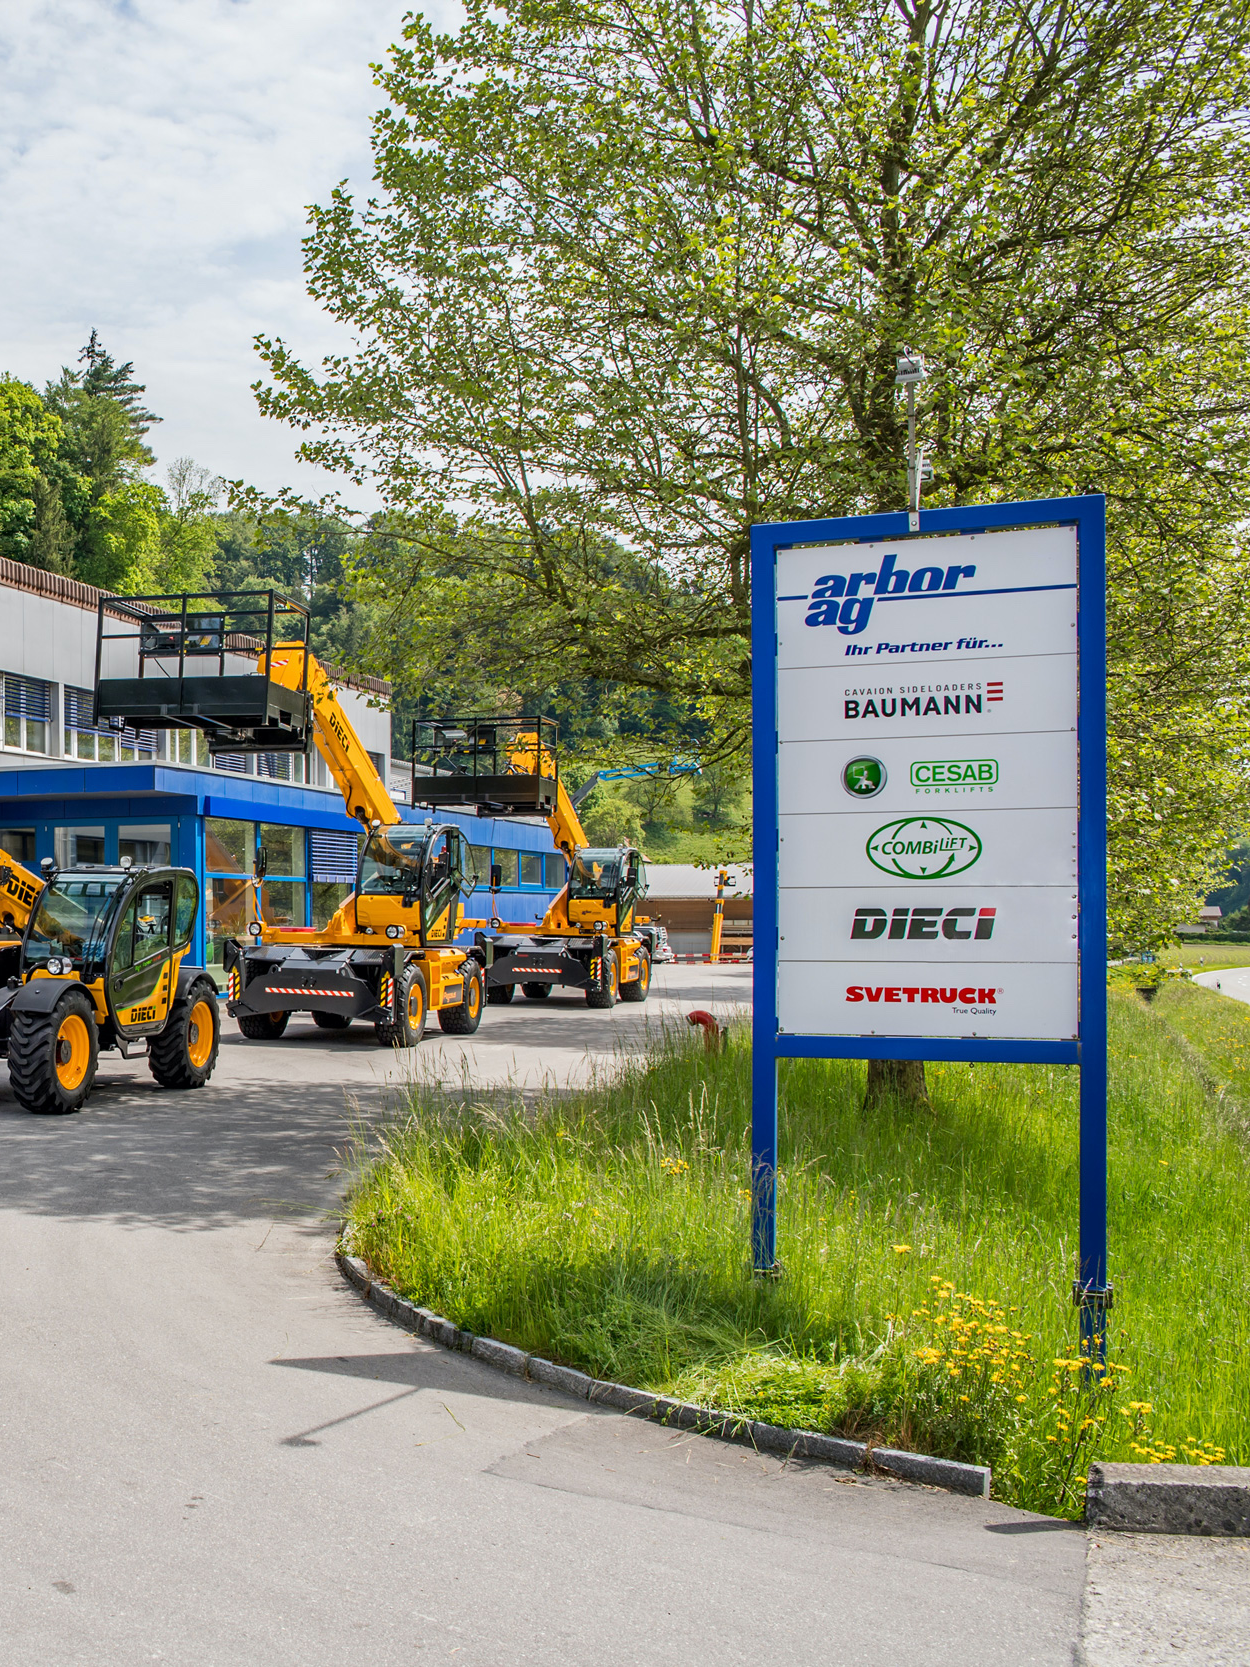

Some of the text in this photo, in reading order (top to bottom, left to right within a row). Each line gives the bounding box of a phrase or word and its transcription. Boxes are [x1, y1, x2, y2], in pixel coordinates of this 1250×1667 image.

[811, 554, 976, 599] arbor
[804, 597, 875, 635] ag
[844, 644, 873, 656] Ihr
[875, 641, 953, 654] Partner
[844, 682, 982, 697] CAVAION SIDELOADERS
[844, 694, 982, 719] BAUMANN
[915, 763, 993, 782] CESAB
[915, 786, 994, 794] FORKLIFTS
[850, 907, 997, 940] DIECI
[845, 986, 997, 1004] SVETRUCK
[952, 1006, 997, 1016] True Quality
